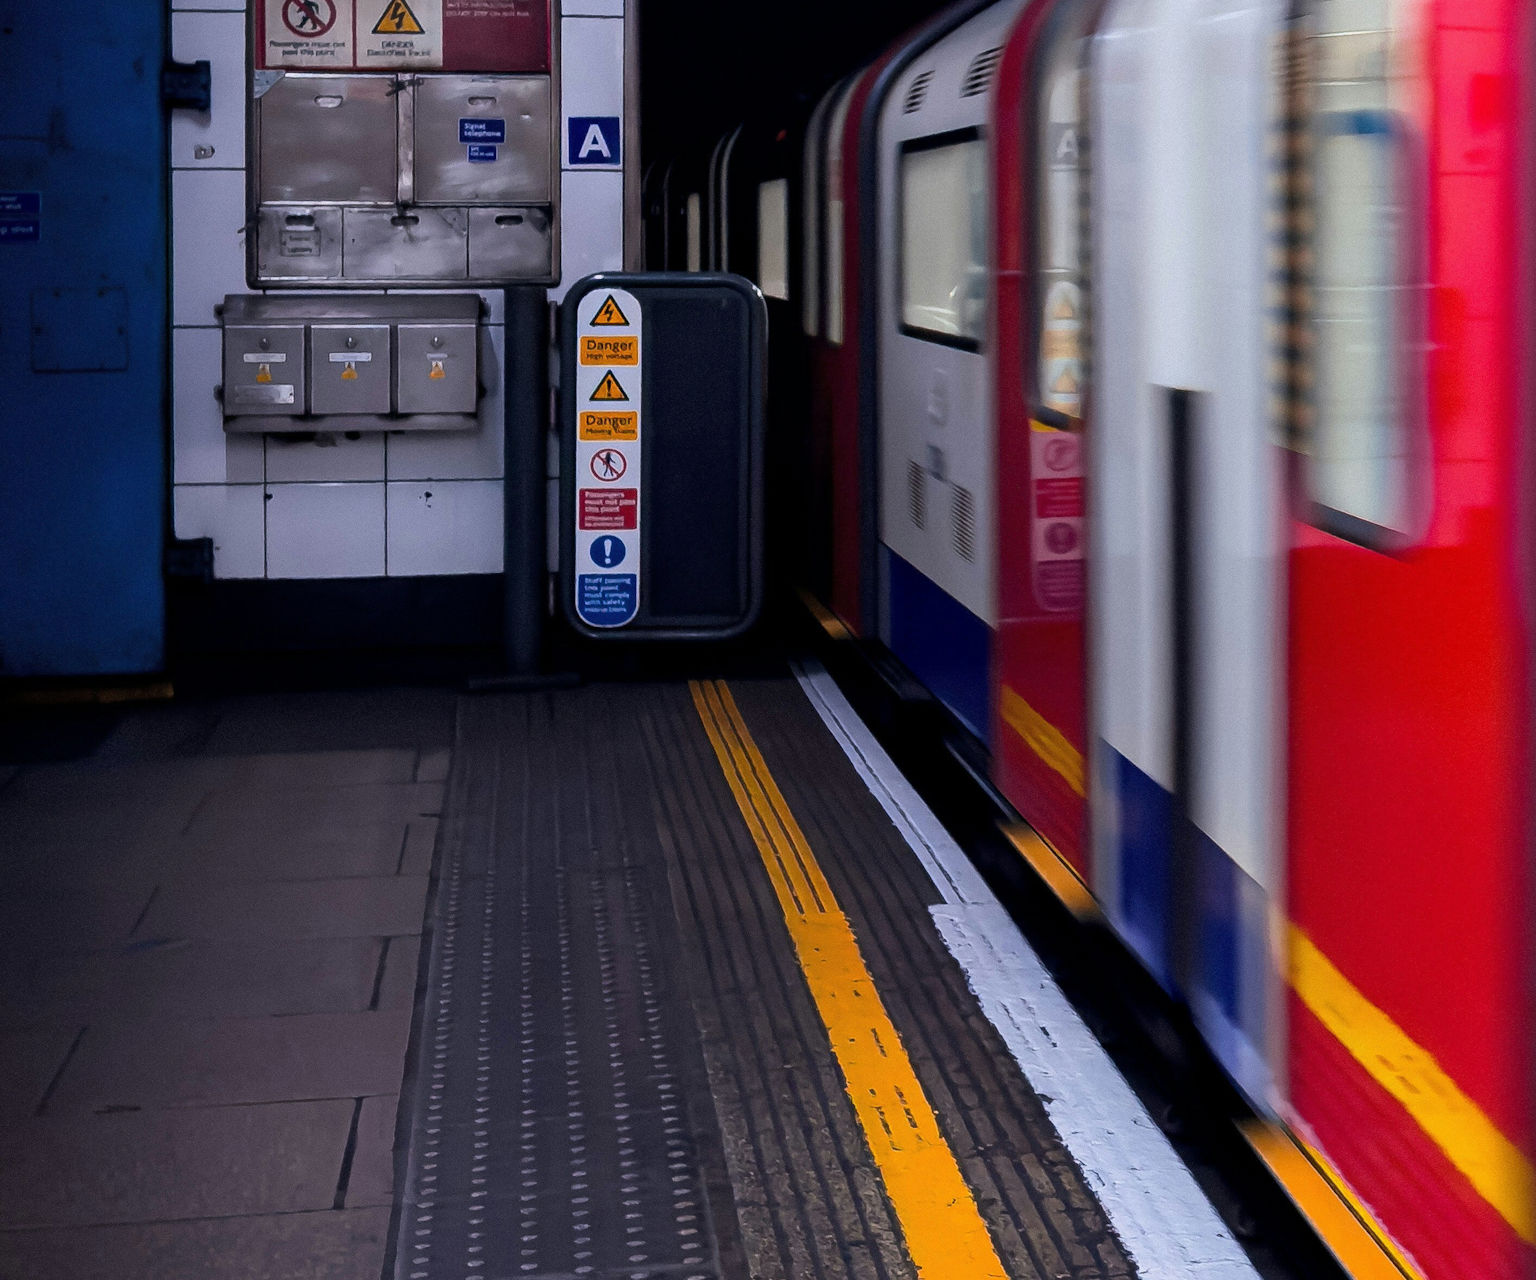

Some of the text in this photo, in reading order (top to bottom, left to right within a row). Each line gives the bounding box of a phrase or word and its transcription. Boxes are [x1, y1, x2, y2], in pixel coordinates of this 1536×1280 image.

[464, 123, 486, 131] Signal
[464, 130, 502, 138] telephone
[578, 123, 612, 159] A
[586, 339, 633, 353] Danger
[586, 414, 633, 428] Danger
